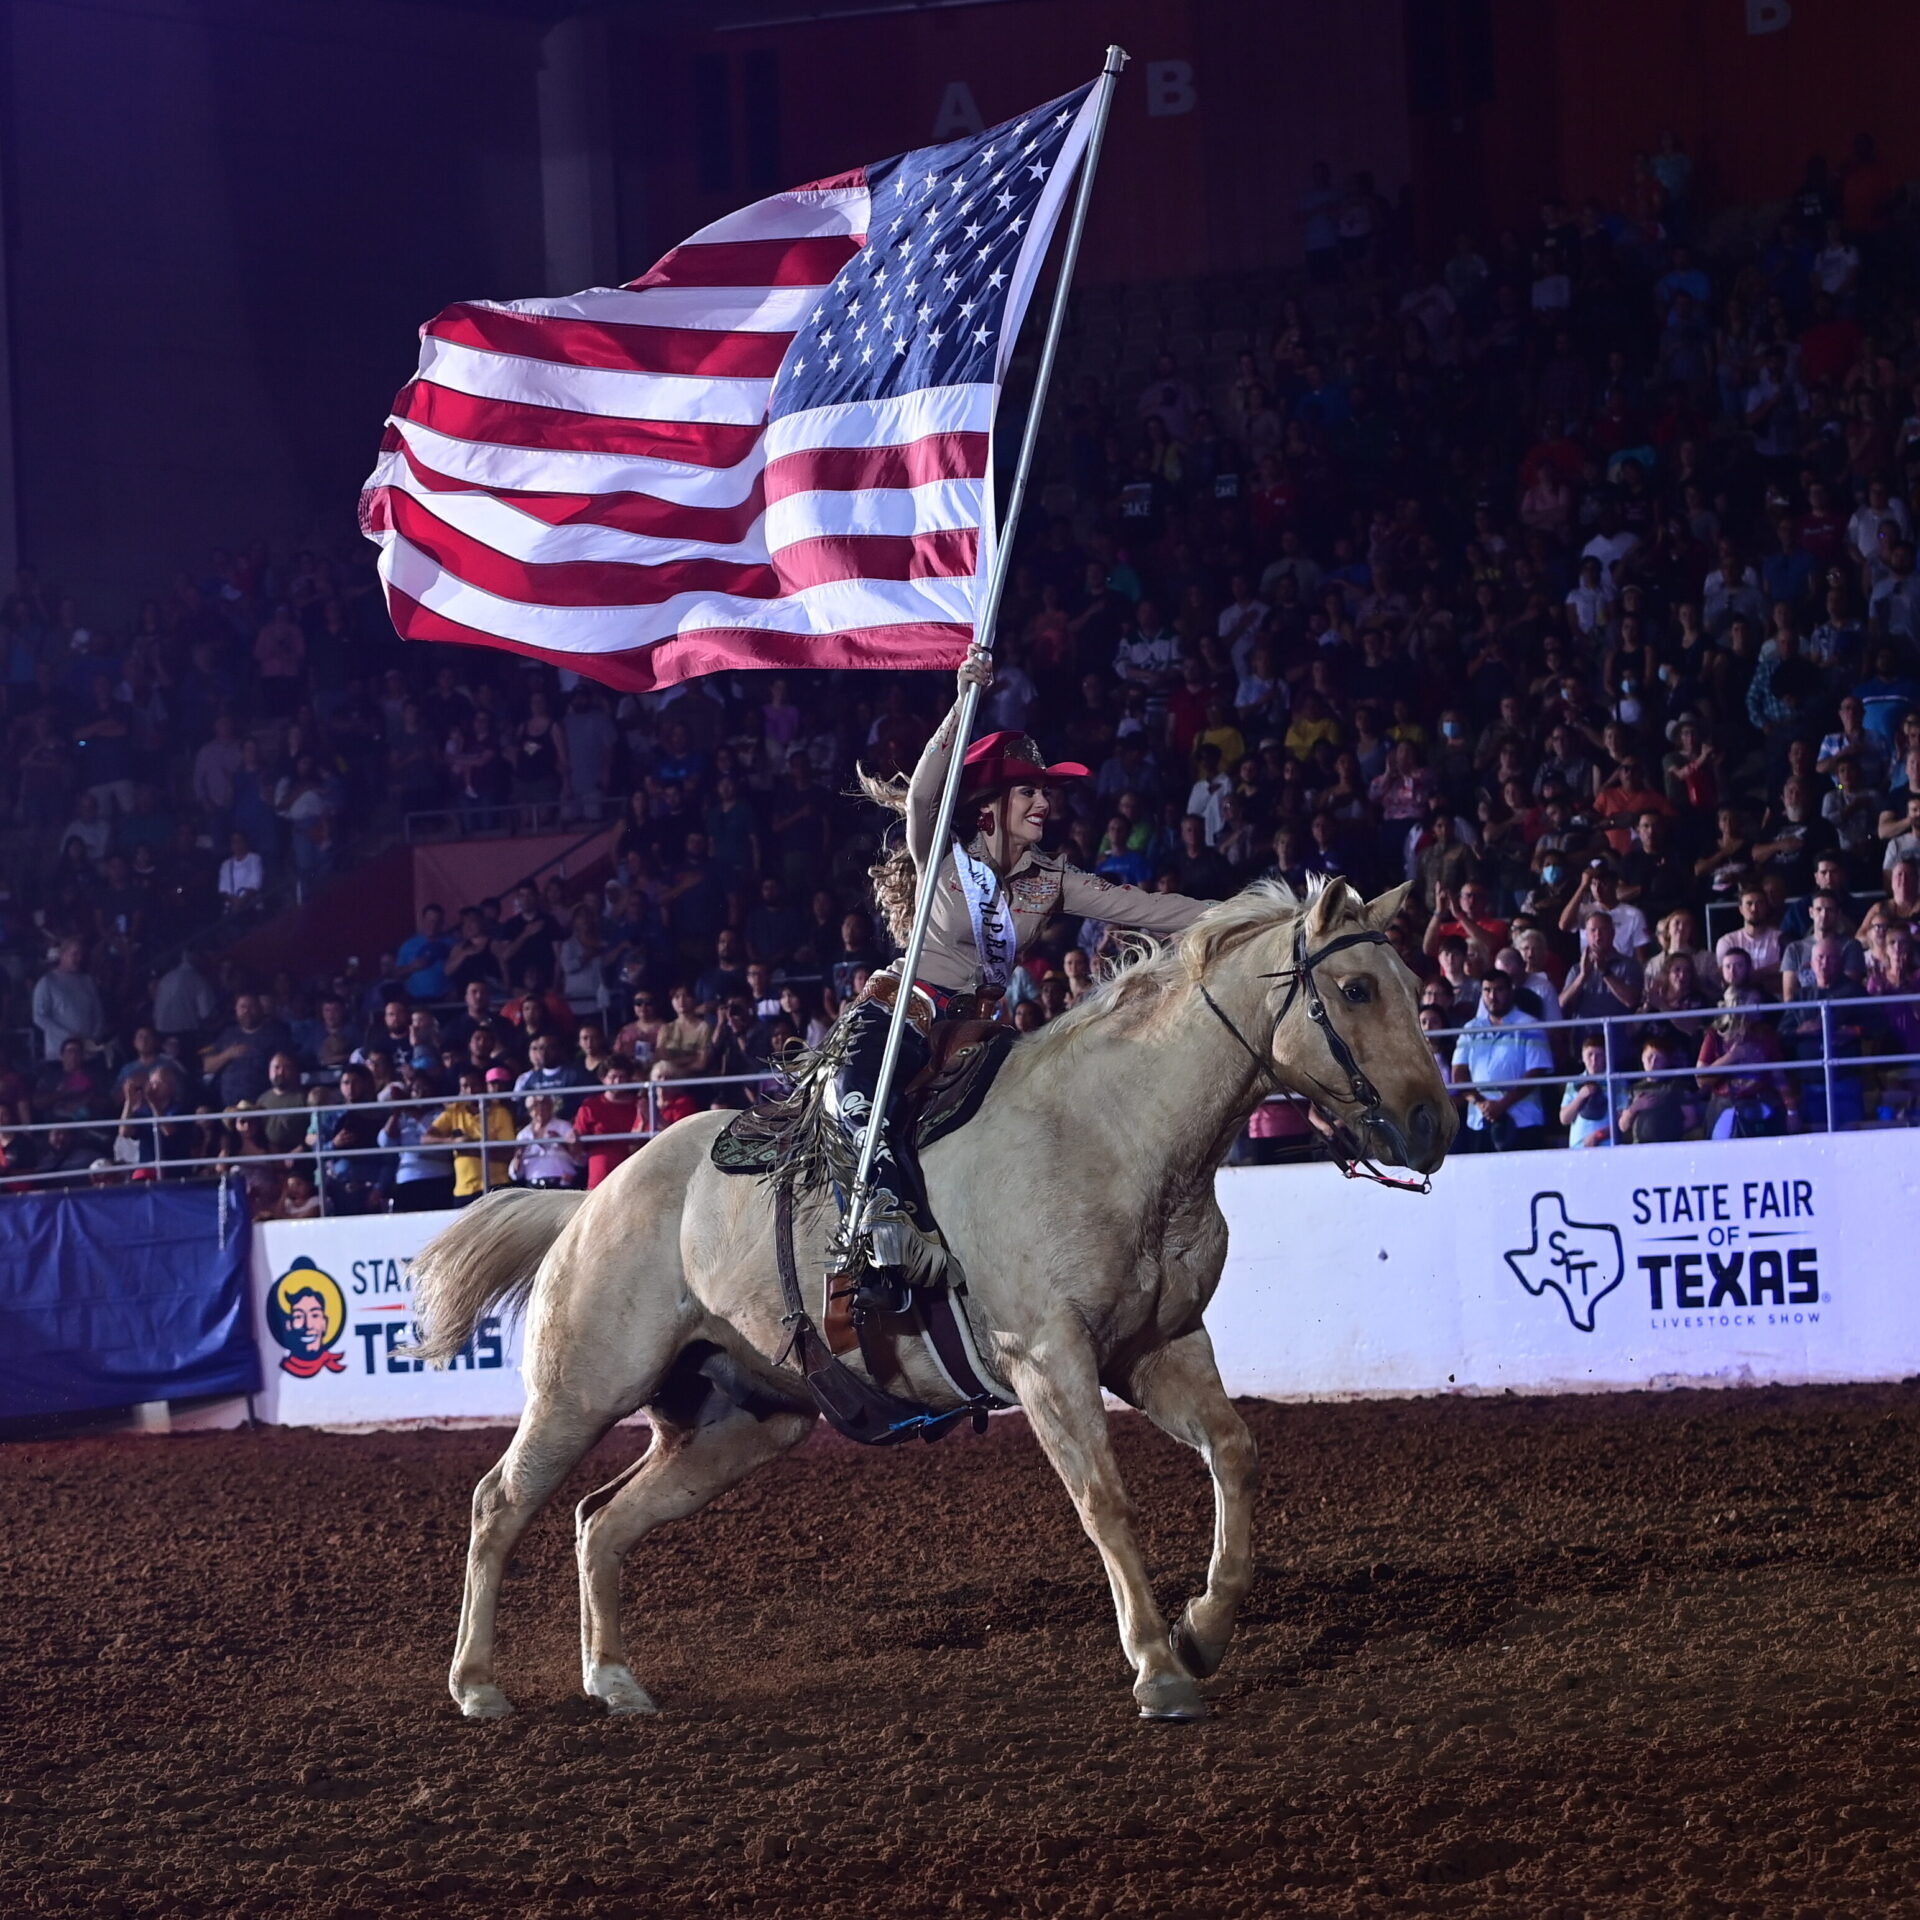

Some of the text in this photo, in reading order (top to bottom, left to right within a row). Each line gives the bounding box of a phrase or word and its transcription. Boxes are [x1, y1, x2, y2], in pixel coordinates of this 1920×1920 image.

[930, 80, 987, 140] A
[1145, 59, 1197, 117] B
[978, 901, 1006, 966] UPRA
[1632, 1180, 1815, 1224] STATE FAIR
[1707, 1226, 1740, 1247] OF
[1637, 1248, 1820, 1310] TEXAS
[1651, 1312, 1821, 1329] LIVESTOCK SHOW
